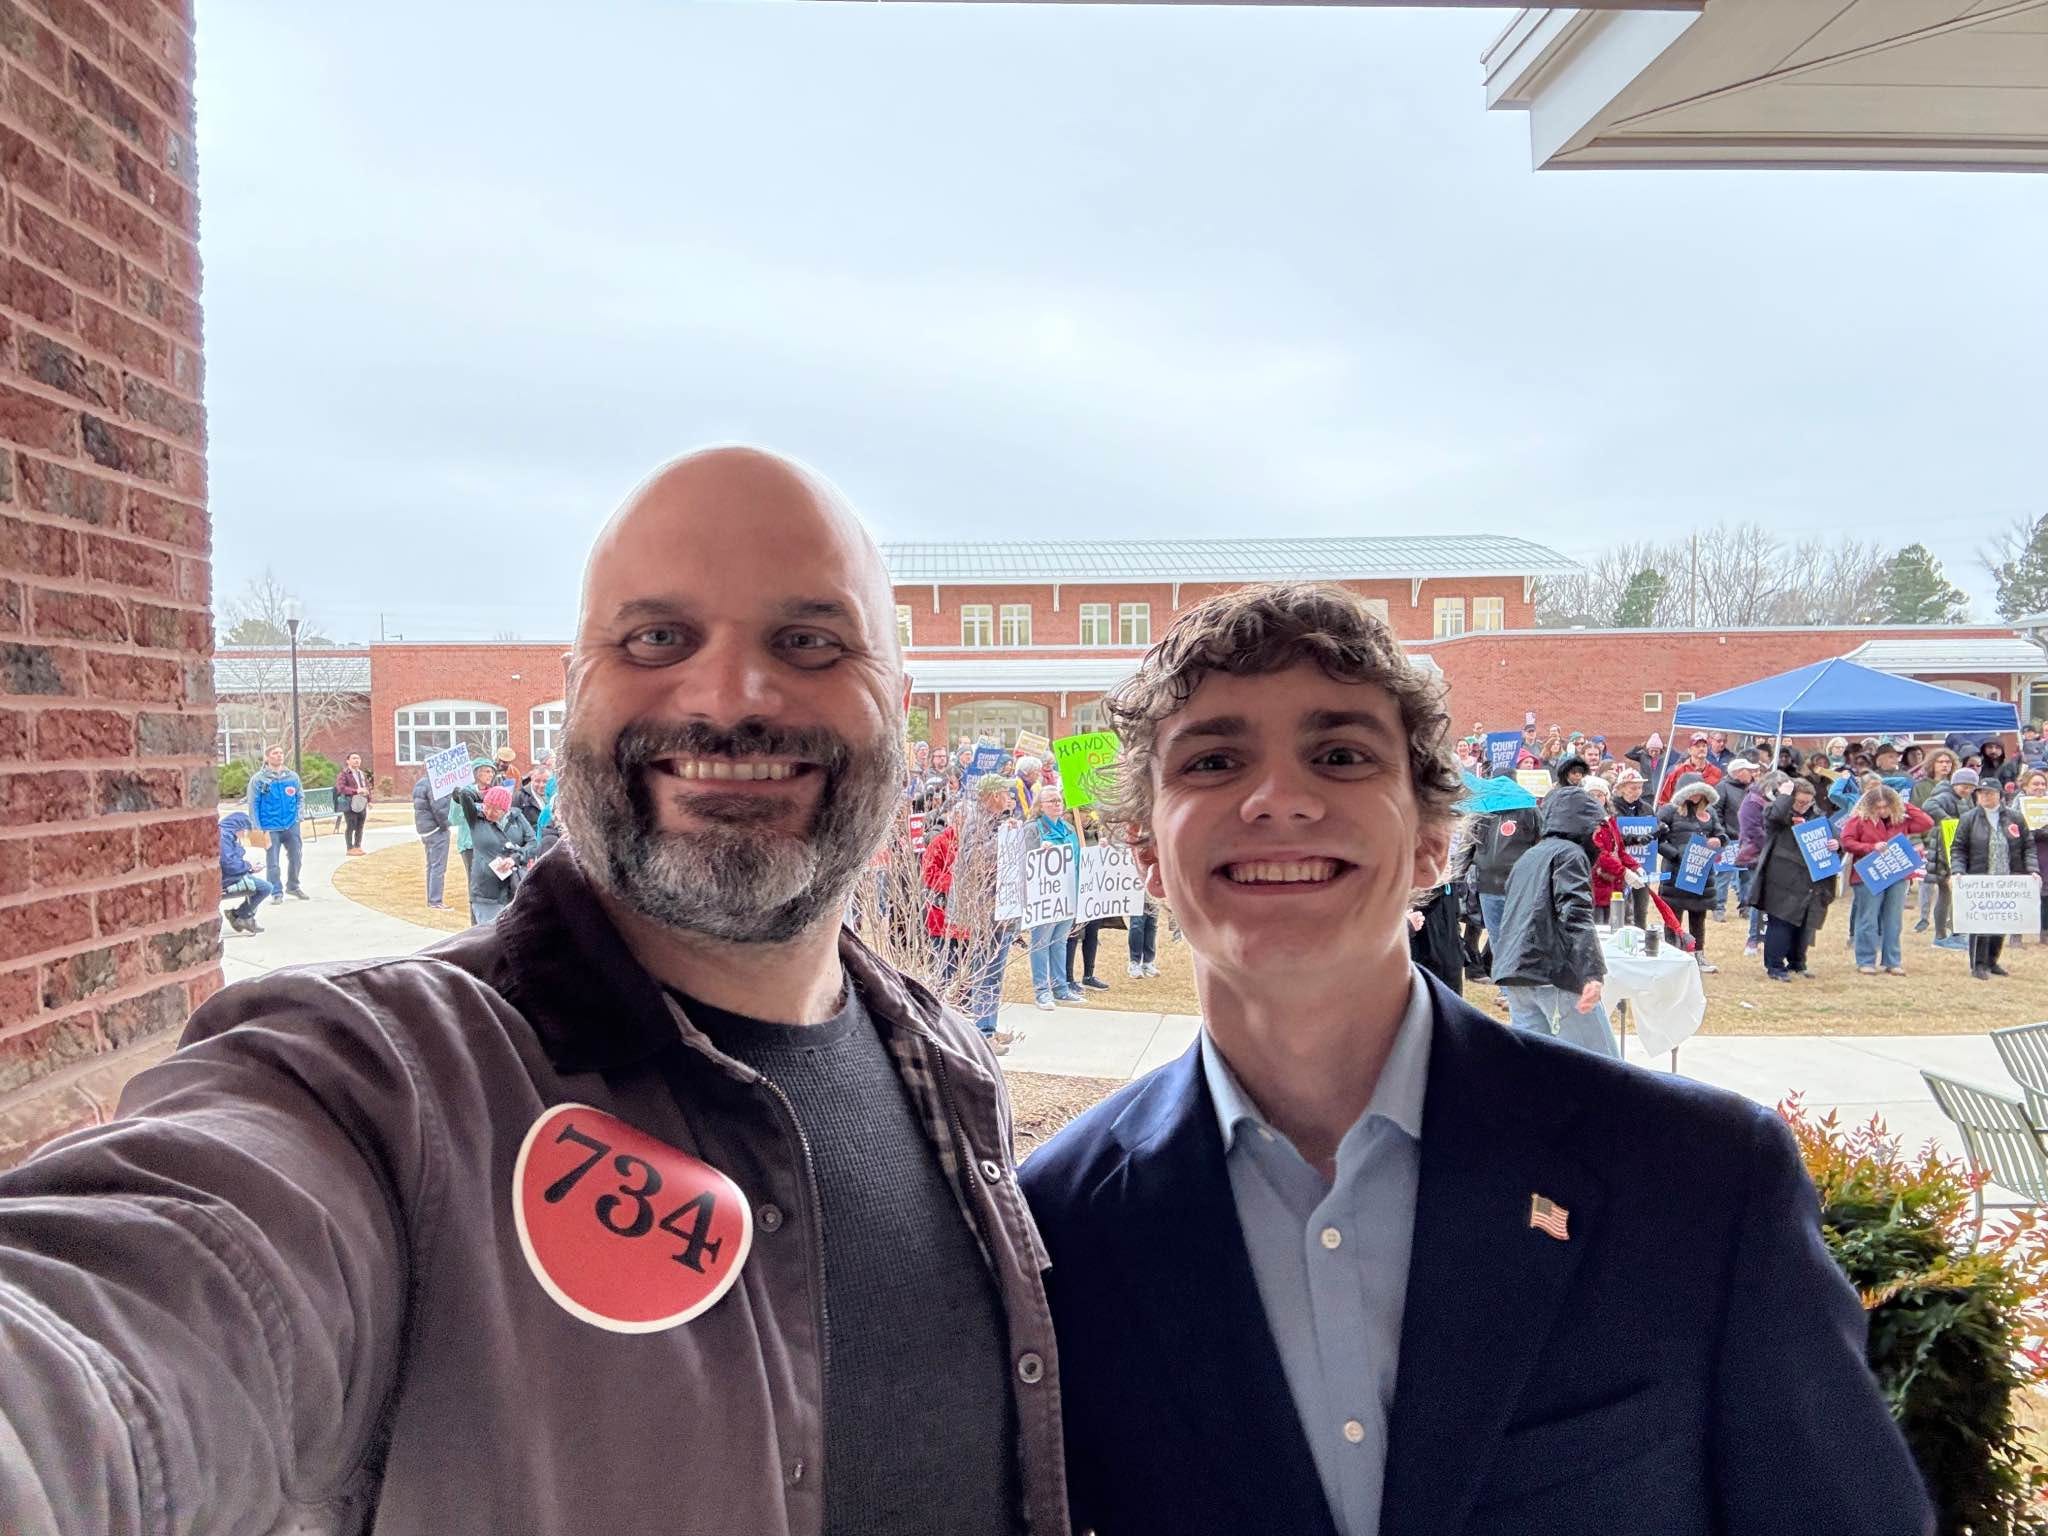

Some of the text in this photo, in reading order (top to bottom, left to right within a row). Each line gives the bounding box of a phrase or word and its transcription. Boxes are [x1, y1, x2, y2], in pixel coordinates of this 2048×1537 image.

[1491, 740, 1518, 752] COUNT
[1492, 751, 1515, 761] EVERY
[1622, 826, 1652, 836] COUNT
[1801, 826, 1827, 843] COUNT
[1625, 845, 1651, 855] VOTE
[1689, 843, 1717, 858] COUNT
[1806, 838, 1829, 853] EVERY
[1026, 845, 1074, 881] STOP
[1081, 853, 1095, 874] My
[1686, 853, 1708, 867] EVERY
[1811, 849, 1832, 861] VOTE
[1889, 842, 1914, 869] COUNT
[1685, 864, 1703, 877] VOTE
[1873, 856, 1892, 879] VOTE
[1040, 876, 1061, 895] the
[1080, 870, 1145, 894] and Voice
[1024, 896, 1074, 924] STEAL
[1085, 895, 1131, 919] Count
[543, 1123, 723, 1275] 734
